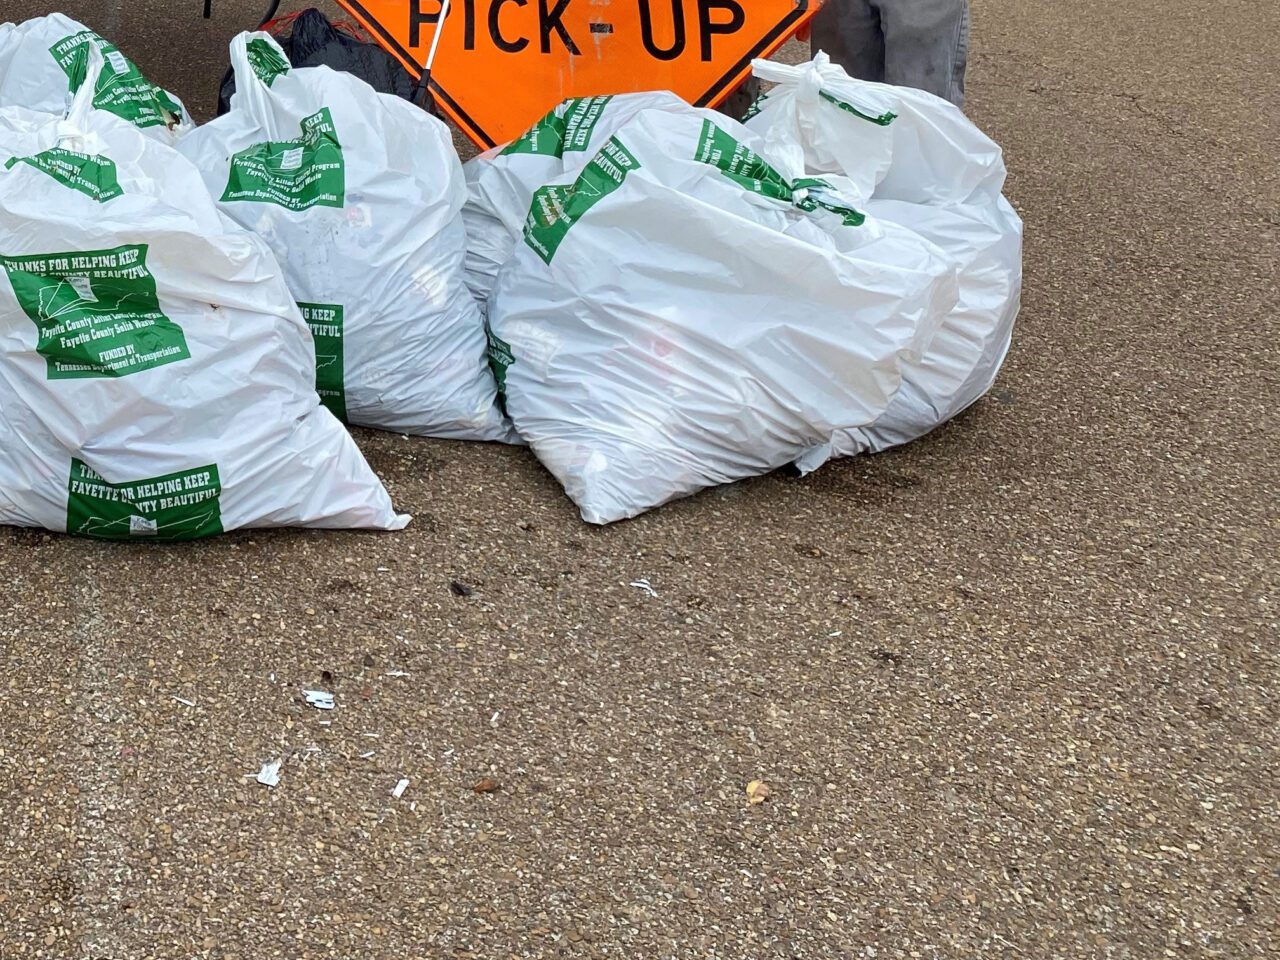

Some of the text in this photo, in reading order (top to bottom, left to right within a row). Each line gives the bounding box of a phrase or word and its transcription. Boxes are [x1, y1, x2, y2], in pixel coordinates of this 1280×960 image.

[575, 128, 588, 145] KEEP
[311, 162, 340, 173] Program
[613, 150, 632, 168] KEEP
[5, 249, 139, 272] THANKS FOR HELPING KEEP
[94, 265, 149, 279] BEAUTIFUL
[312, 309, 335, 322] KEEP
[41, 323, 66, 339] Fayette
[67, 317, 93, 332] County
[60, 333, 90, 348] Fayette
[90, 327, 115, 340] County
[114, 321, 134, 334] Solid
[307, 323, 340, 337] TIFUL
[99, 344, 136, 362] FUNDED BY
[129, 356, 136, 367] of
[135, 345, 181, 364] Transportation
[80, 464, 104, 481] THA
[137, 477, 182, 498] HELPING
[184, 472, 210, 489] KEEP
[71, 480, 119, 502] FAYETTE
[160, 488, 220, 510] BEAUTIFUL
